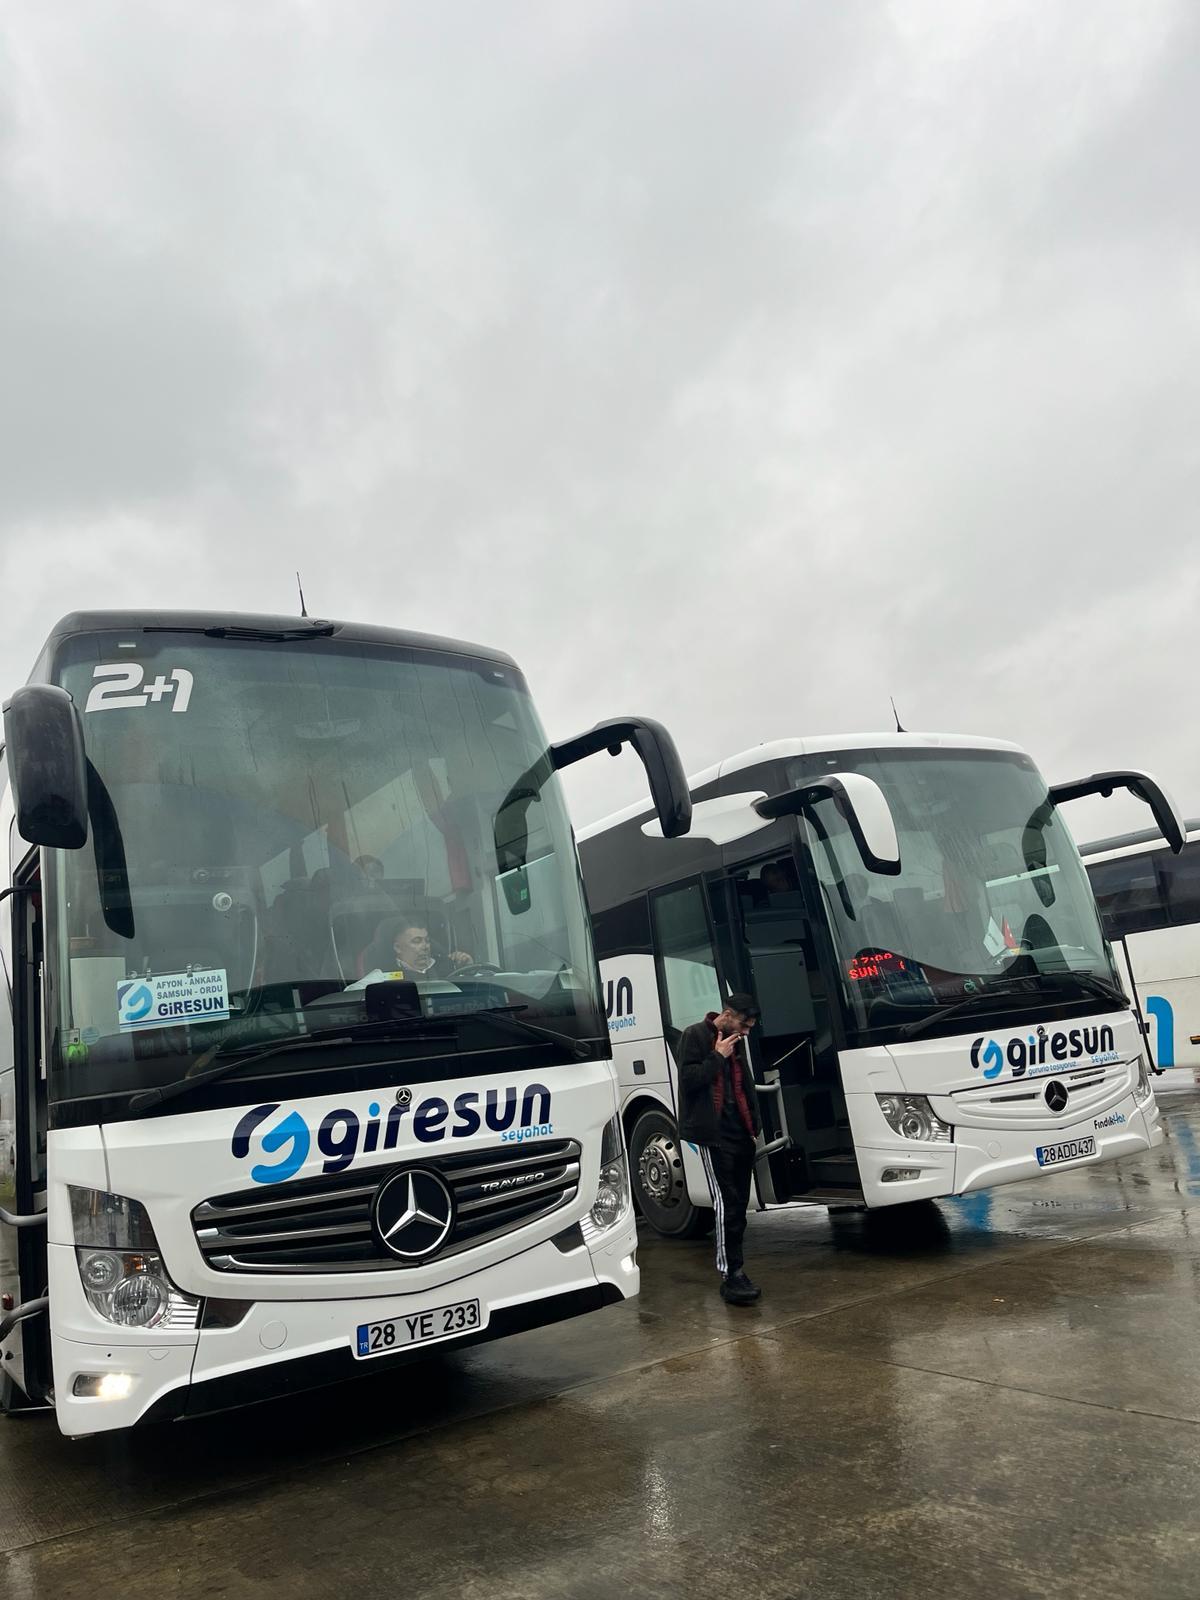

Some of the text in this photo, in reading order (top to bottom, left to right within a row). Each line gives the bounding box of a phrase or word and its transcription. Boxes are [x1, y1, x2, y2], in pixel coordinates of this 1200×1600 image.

[85, 662, 194, 713] 2+1
[156, 980, 183, 990] AFYON
[189, 975, 222, 986] ANKARA
[156, 988, 193, 1000] SAMSUN
[199, 985, 223, 995] ORDU
[1007, 1024, 1115, 1077] giresun
[317, 1083, 552, 1174] giresun
[501, 1123, 553, 1143] seyahat
[481, 1172, 545, 1192] TRAVEGO
[360, 1303, 478, 1350] TR 28 YE 233
